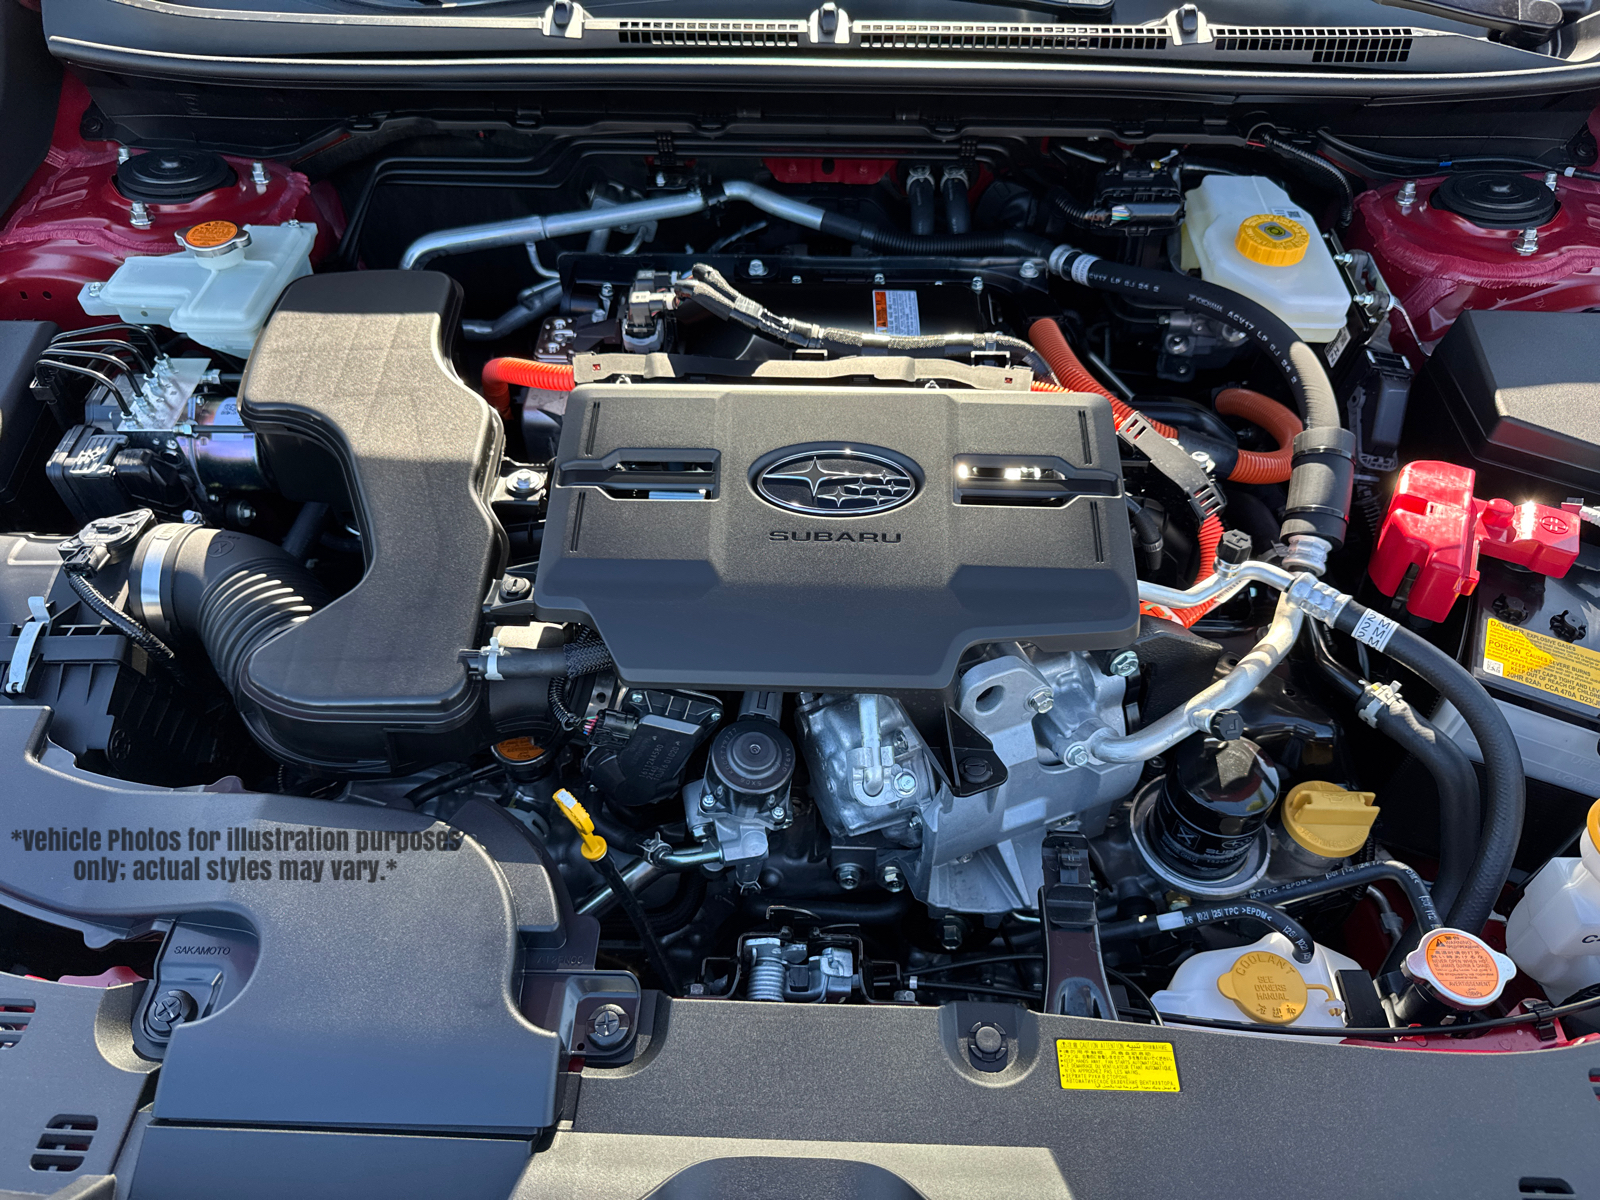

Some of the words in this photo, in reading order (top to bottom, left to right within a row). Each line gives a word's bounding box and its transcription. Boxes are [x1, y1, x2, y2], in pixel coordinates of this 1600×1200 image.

[768, 530, 902, 544] SUBARU
[1361, 622, 1371, 632] 2
[1372, 627, 1386, 638] M
[1367, 614, 1376, 622] 2
[1378, 619, 1390, 630] M
[1368, 636, 1380, 646] M
[1490, 620, 1523, 634] DANGER
[1526, 632, 1555, 645] EXPLOSIVE
[1557, 641, 1576, 651] GASES
[1488, 639, 1520, 654] POISON
[1525, 651, 1547, 662] CAUSES
[1548, 658, 1570, 669] SEVERE
[1571, 666, 1590, 676] BURNS
[1510, 666, 1525, 674] KEEP
[1547, 677, 1567, 688] REACH
[1511, 660, 1525, 669] KEEP
[1526, 666, 1541, 674] VENT
[1542, 670, 1556, 679] CAPS
[1558, 675, 1574, 685] TIGHT
[1575, 681, 1587, 689] AND
[1506, 670, 1523, 681] 20HR
[1524, 676, 1541, 686] 62Ah
[1544, 683, 1558, 692] CCA
[1560, 688, 1576, 698] 470A
[1224, 907, 1239, 916] TPC
[174, 946, 231, 956] SAKAMOTO
[1236, 953, 1296, 976] COOLANT
[1257, 976, 1274, 984] SEE
[1256, 992, 1289, 1001] MANUAL
